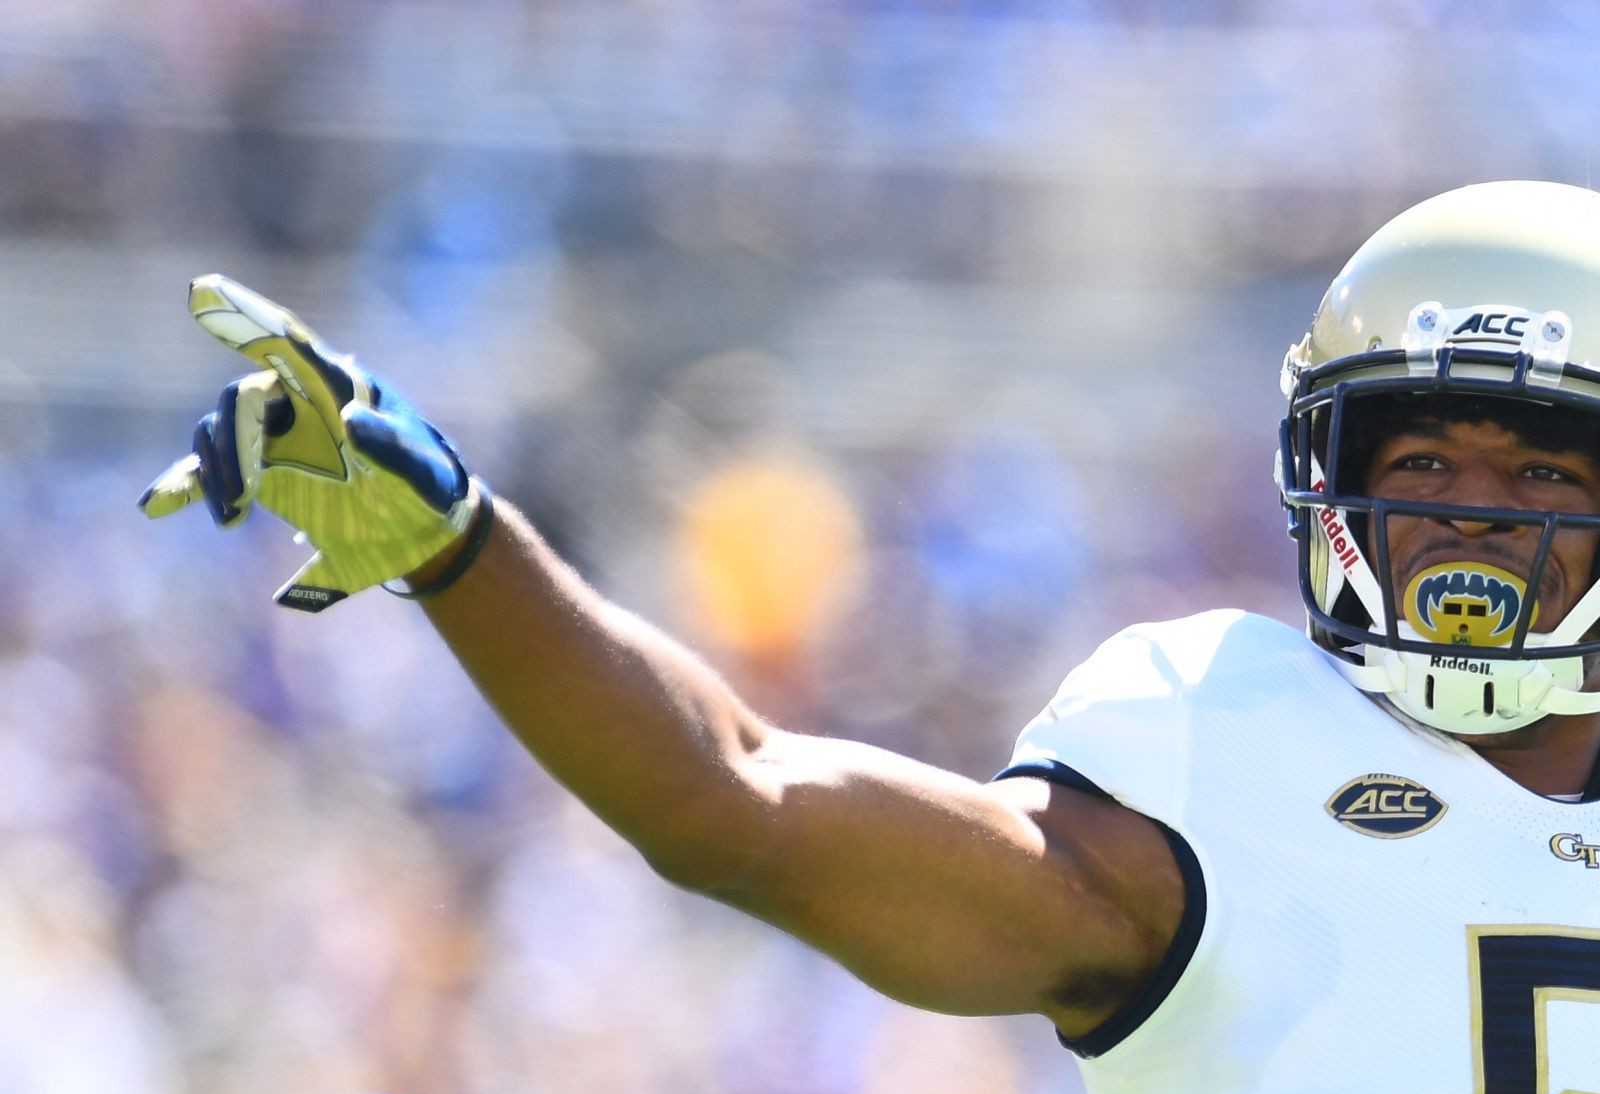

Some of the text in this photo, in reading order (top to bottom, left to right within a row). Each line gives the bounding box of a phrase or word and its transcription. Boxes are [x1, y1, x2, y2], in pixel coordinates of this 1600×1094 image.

[1452, 312, 1530, 338] ACC
[1430, 655, 1491, 676] Riddell
[1344, 789, 1428, 814] ACC
